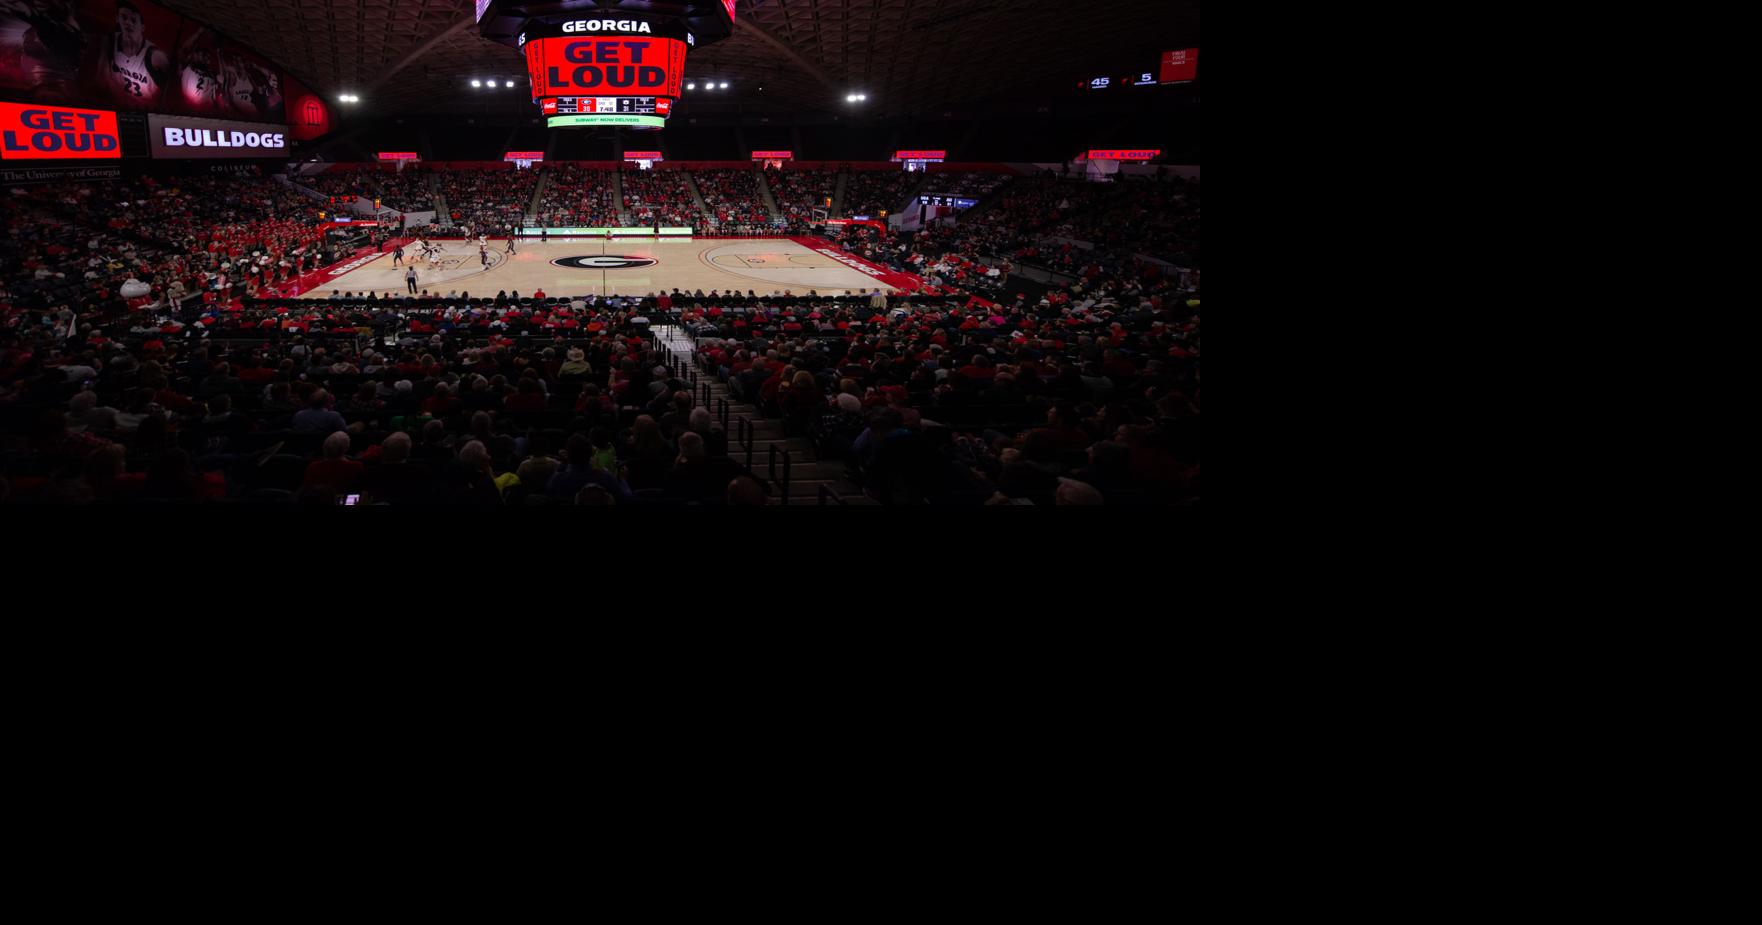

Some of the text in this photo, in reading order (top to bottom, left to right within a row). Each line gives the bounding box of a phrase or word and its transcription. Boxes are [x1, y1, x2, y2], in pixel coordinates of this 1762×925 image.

[562, 19, 651, 33] GEORGIA
[565, 41, 651, 63] GET
[124, 76, 142, 96] 23
[196, 77, 204, 90] 2
[549, 66, 666, 87] LOUD
[1091, 78, 1109, 86] 45
[21, 109, 101, 131] GET
[3, 130, 117, 151] LOUD
[164, 127, 286, 148] BULLDOGS
[1119, 151, 1156, 159] LOUD
[3, 171, 25, 180] The
[87, 168, 120, 178] Georgia
